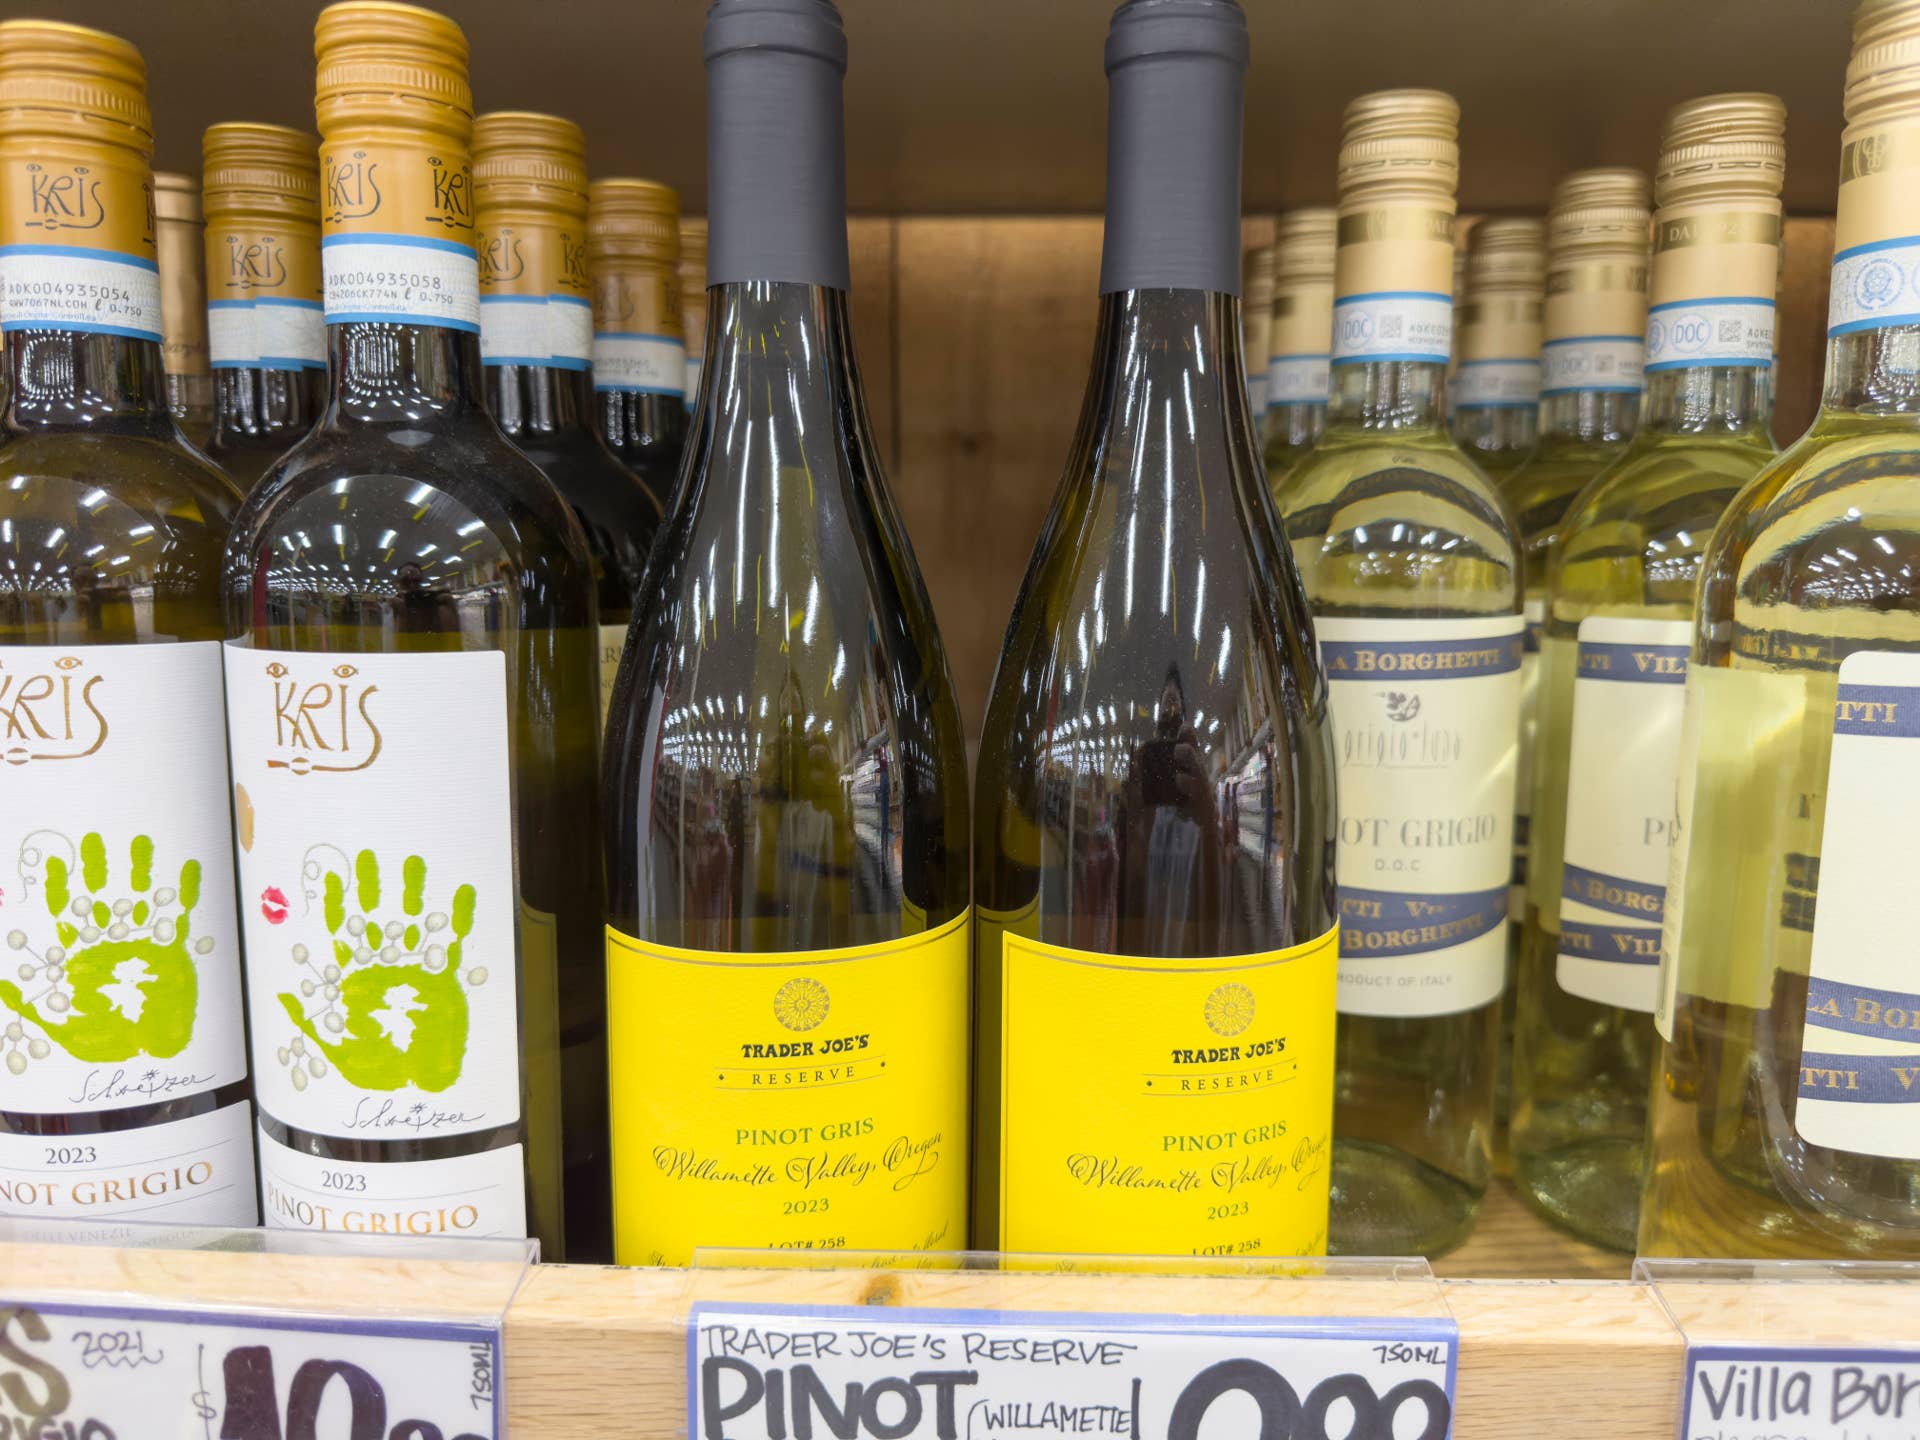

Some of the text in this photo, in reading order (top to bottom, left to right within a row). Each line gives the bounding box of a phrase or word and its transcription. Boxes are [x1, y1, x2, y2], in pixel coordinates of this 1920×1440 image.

[25, 163, 105, 231] KRIS
[1674, 322, 1705, 344] DOC
[1354, 649, 1500, 672] BORGHETTI
[266, 662, 382, 776] KRIS
[742, 1034, 870, 1059] TRADER JOE'S
[1171, 1037, 1287, 1065] TRADER JOE'S
[752, 1066, 856, 1086] RESERVE
[1181, 1069, 1274, 1092] RESERVE
[736, 1117, 874, 1145] PINOT GRIS
[1162, 1120, 1288, 1151] PINOT GRIS
[45, 1146, 97, 1164] 2023
[652, 1145, 778, 1186] Willamette
[882, 1132, 944, 1192] Oregon
[71, 1160, 213, 1206] GRIGIO
[321, 1170, 367, 1192] 2023
[1066, 1153, 1202, 1193] Willamette
[267, 1180, 479, 1236] PINOT GRIGIO
[783, 1198, 830, 1216] 2023
[1207, 1201, 1249, 1220] 2023
[72, 1330, 144, 1356] 2021
[700, 1326, 1138, 1366] TRADER JOE'S RESERVE
[1373, 1344, 1446, 1365] 750ML
[702, 1355, 980, 1440] PINOT
[1698, 1365, 1811, 1421] Villa
